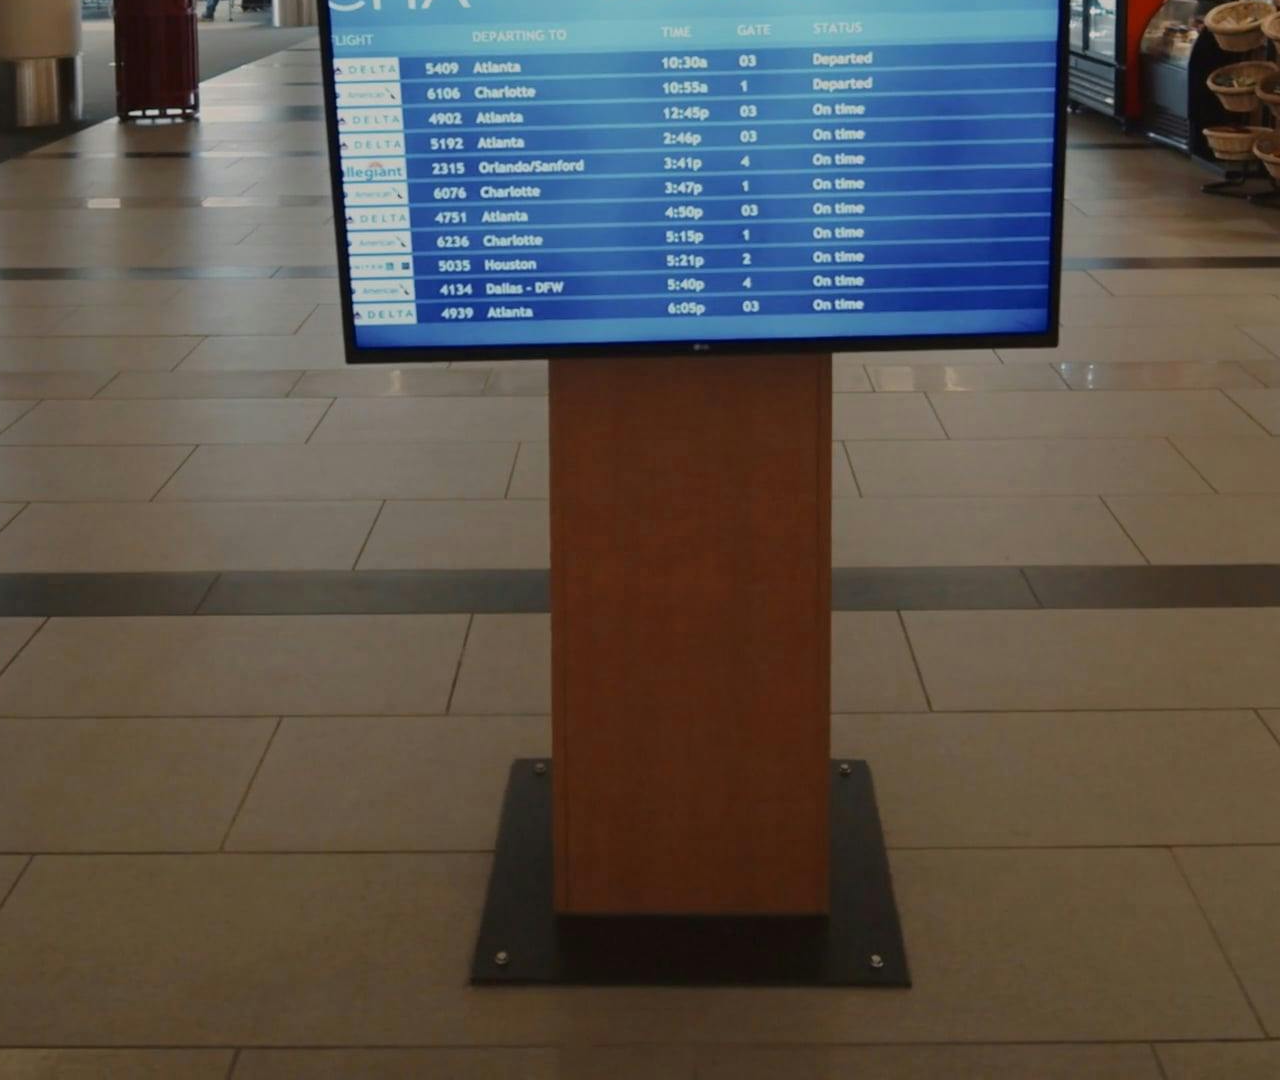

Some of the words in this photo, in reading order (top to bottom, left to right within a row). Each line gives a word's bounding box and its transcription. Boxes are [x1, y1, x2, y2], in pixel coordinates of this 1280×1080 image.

[472, 29, 545, 42] DEPARTING
[548, 28, 568, 41] TO
[661, 26, 690, 38] TIME
[736, 23, 771, 36] GATE
[812, 21, 863, 35] STATUS
[348, 65, 396, 74] DELTA
[425, 62, 460, 75] 5409
[473, 61, 522, 74] Atlanta
[661, 55, 708, 69] 10:30a
[738, 54, 757, 68] 03
[812, 52, 873, 67] Departed
[426, 87, 461, 100] 6106
[474, 85, 537, 99] Charlotte
[662, 80, 709, 94] 10:55a
[740, 79, 748, 93] 1
[812, 76, 873, 93] Departed
[428, 112, 463, 125] 4902
[475, 111, 524, 124] Atlanta
[663, 106, 710, 121] 12:45p
[739, 104, 758, 118] 03
[812, 103, 833, 116] On
[834, 103, 866, 115] time
[354, 140, 401, 149] DELTA
[430, 137, 464, 150] 5192
[477, 136, 525, 149] Atlanta
[663, 131, 702, 146] 2:46p
[739, 129, 758, 143] 03
[812, 128, 833, 141] On
[834, 127, 866, 141] time
[431, 161, 466, 175] 2315
[478, 159, 585, 174] Orlando/Sanford
[664, 156, 703, 171] 3:41p
[740, 155, 750, 167] 4
[812, 153, 832, 166] On
[834, 152, 865, 165] time
[433, 186, 467, 200] 6076
[479, 185, 541, 199] Charlotte
[664, 181, 703, 196] 3:47p
[741, 180, 749, 192] 1
[434, 211, 467, 224] 4751
[481, 210, 529, 223] Atlanta
[664, 205, 704, 220] 4:50p
[740, 203, 759, 217] 03
[436, 235, 470, 248] 6236
[482, 234, 544, 247] Charlotte
[665, 229, 704, 245] 5:15p
[742, 228, 750, 241] 1
[438, 259, 471, 272] 5035
[484, 259, 537, 271] Houston
[666, 254, 705, 269] 5:21p
[742, 252, 752, 265] 2
[439, 283, 473, 296] 4134
[485, 282, 524, 295] Dallas
[534, 281, 564, 294] DFW
[667, 278, 705, 292] 5:40p
[742, 277, 752, 289] 4
[368, 309, 413, 319] DELTA
[441, 306, 474, 319] 4939
[487, 306, 534, 318] Atlanta
[667, 301, 706, 316] 6:05p
[742, 300, 760, 313] 03
